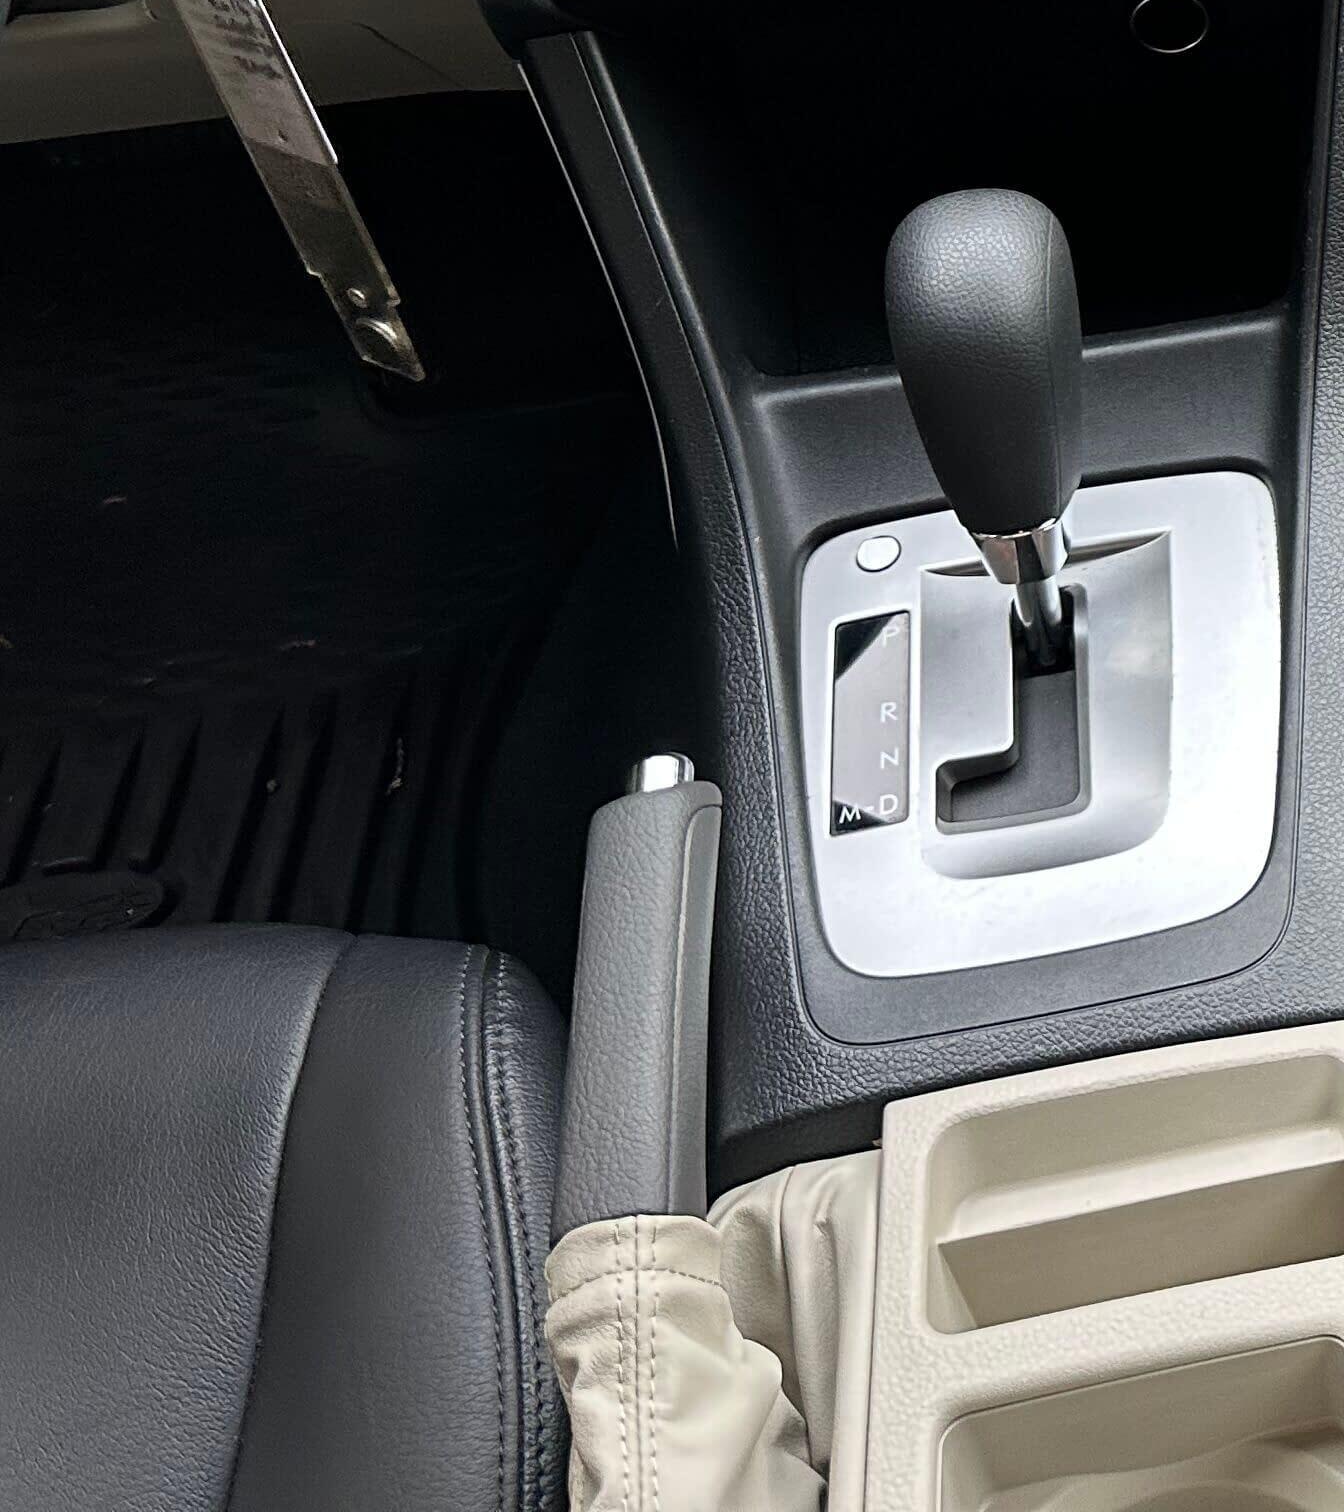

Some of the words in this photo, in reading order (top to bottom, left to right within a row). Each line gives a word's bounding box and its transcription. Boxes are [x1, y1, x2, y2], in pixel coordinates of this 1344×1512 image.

[882, 626, 900, 647] P
[880, 701, 898, 723] R
[880, 747, 899, 769] N
